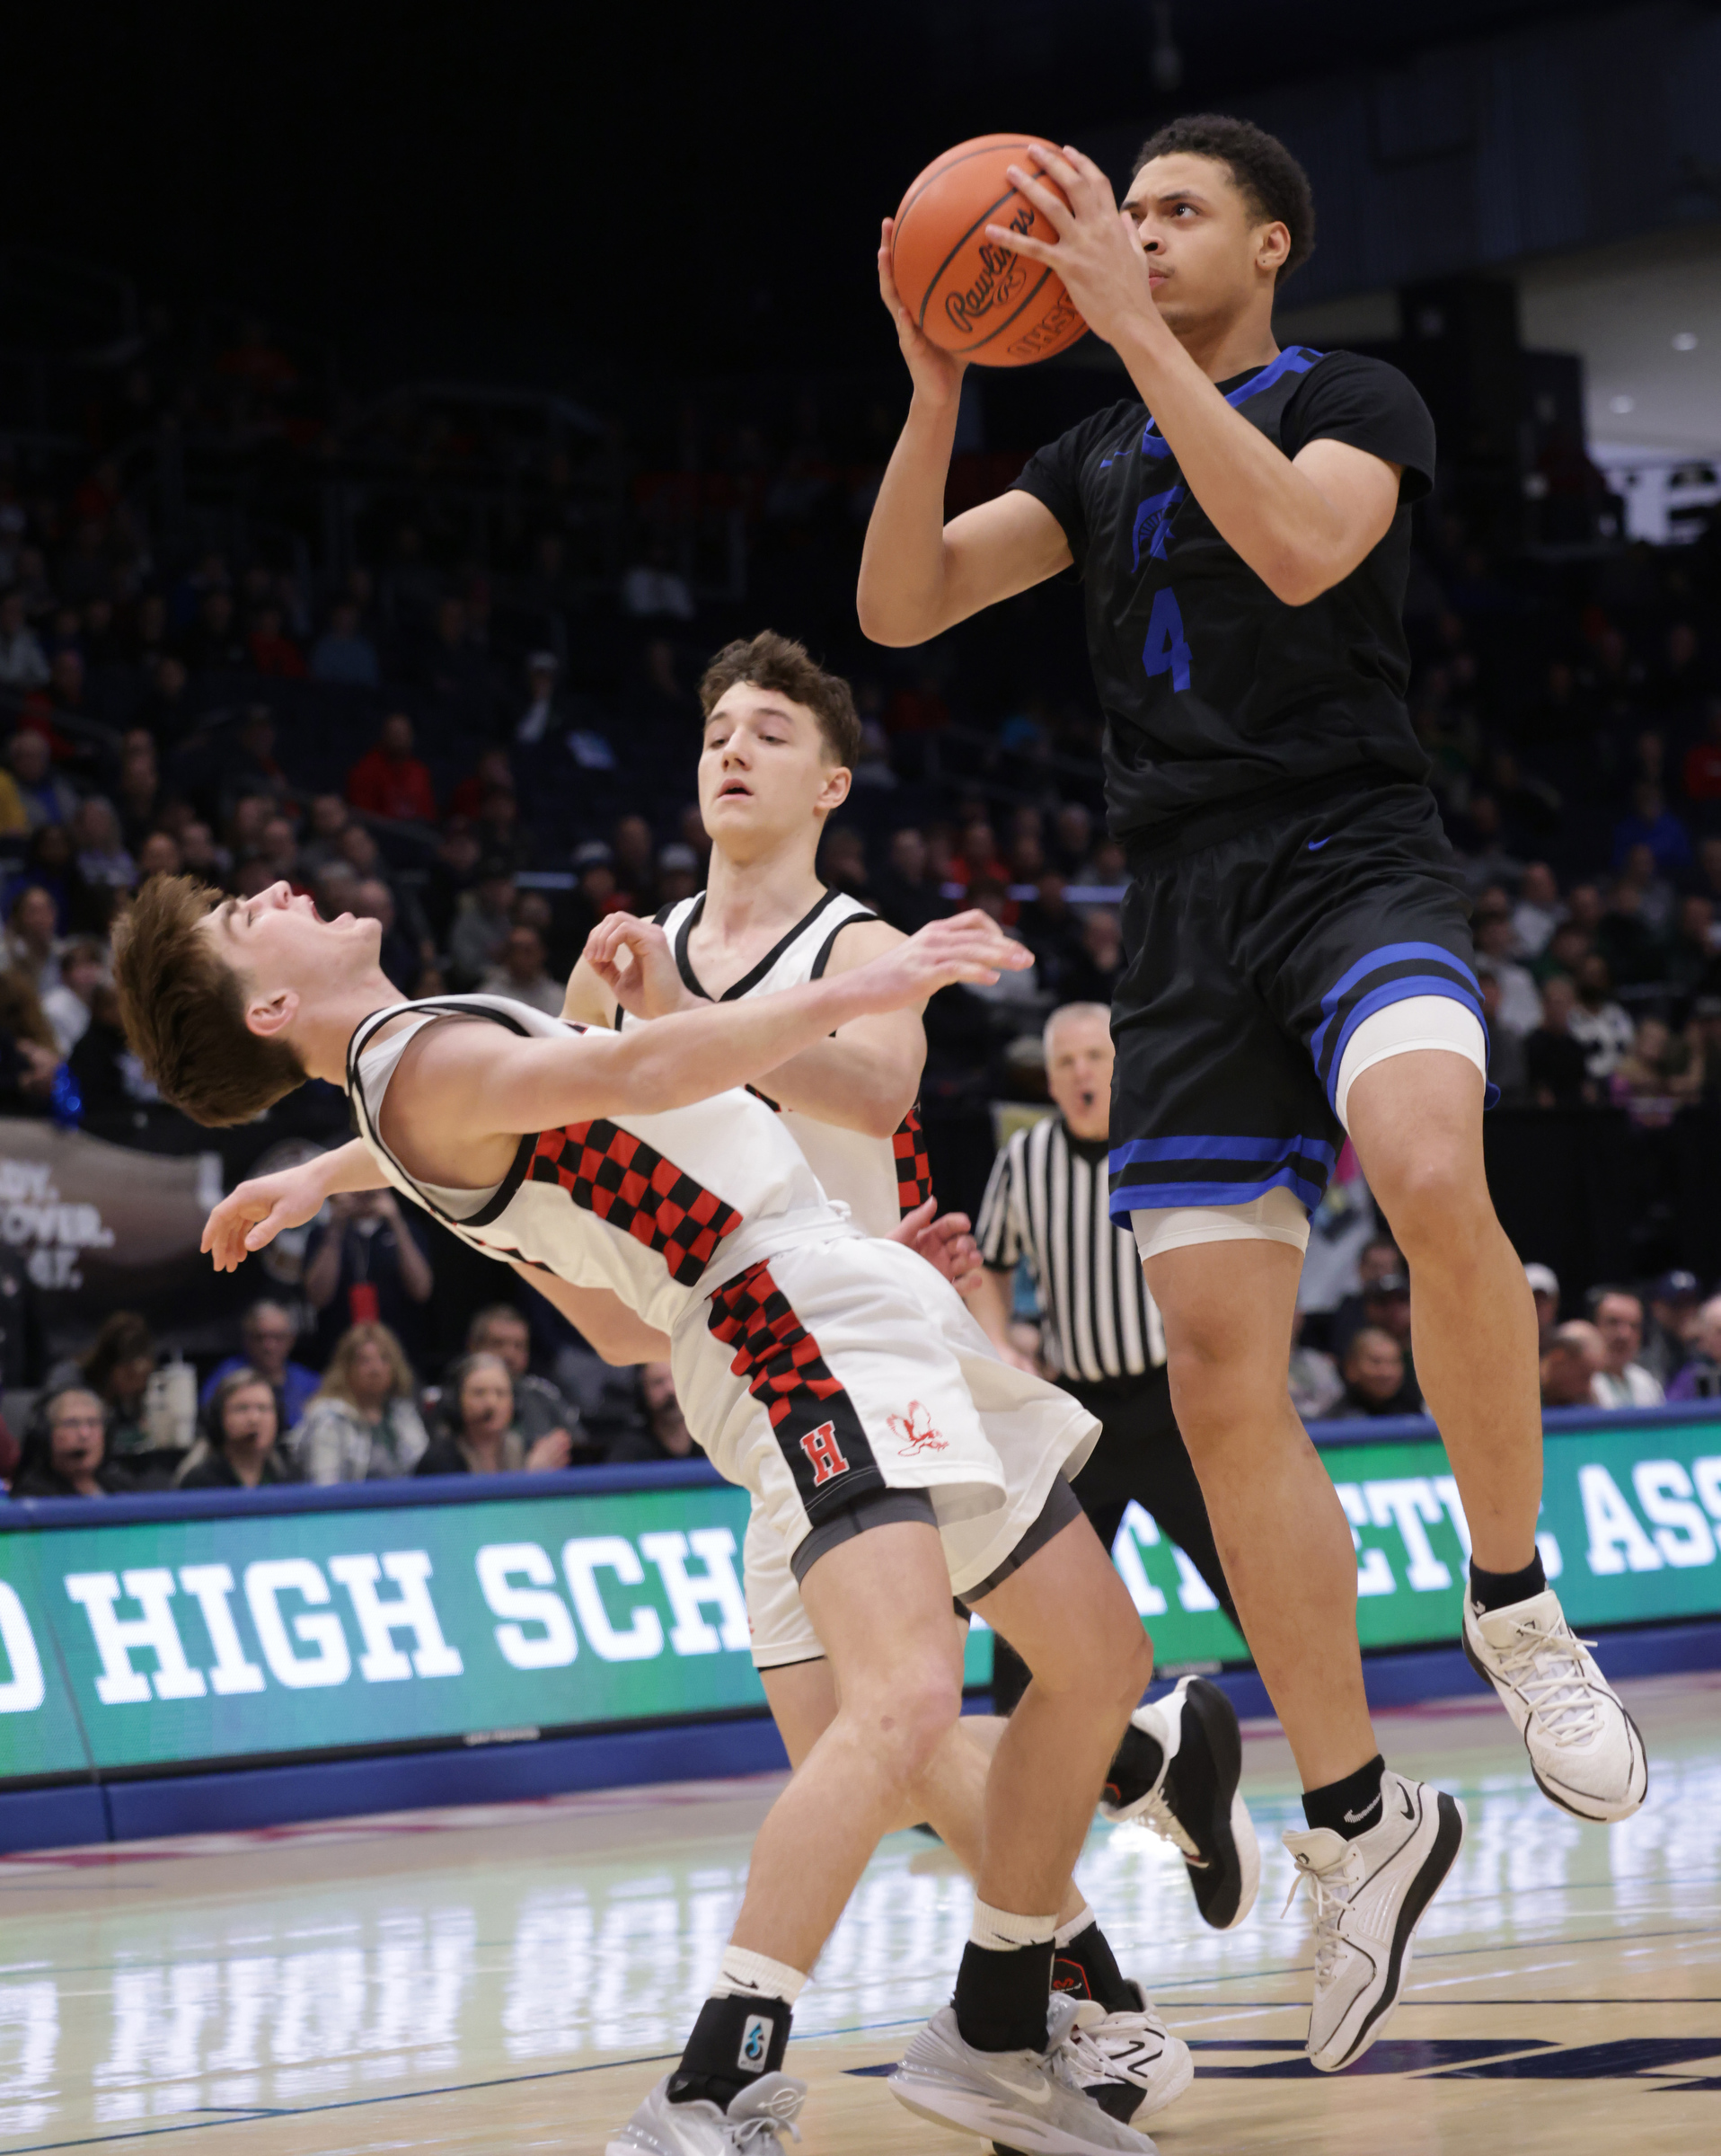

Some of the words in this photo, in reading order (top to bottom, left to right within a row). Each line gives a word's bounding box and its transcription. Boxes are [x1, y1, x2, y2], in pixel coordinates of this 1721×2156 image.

[1142, 586, 1193, 693] 4
[799, 1420, 850, 1487] H
[65, 1550, 463, 1704] HIGH
[475, 1527, 751, 1670] SCH
